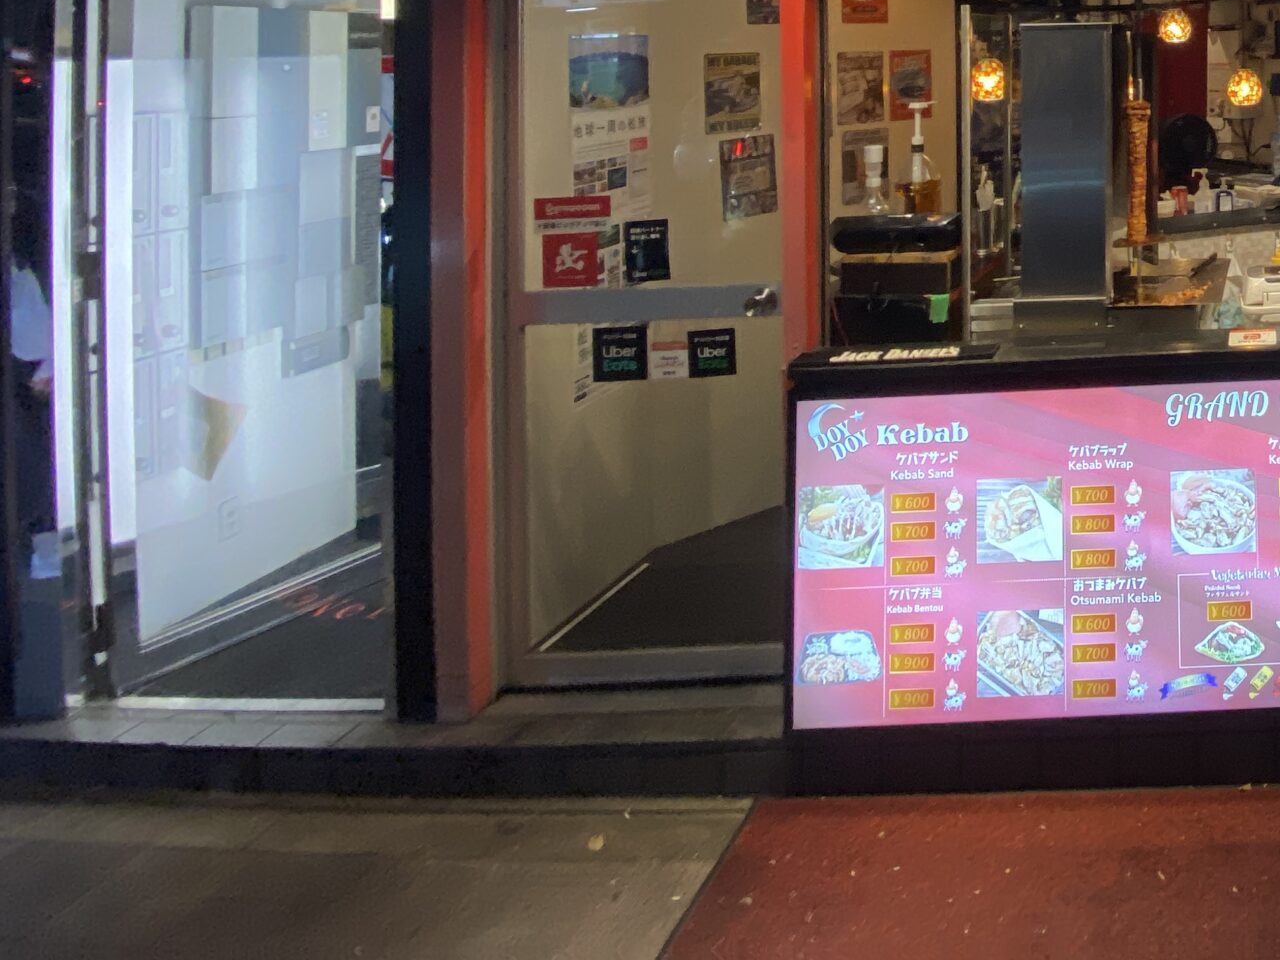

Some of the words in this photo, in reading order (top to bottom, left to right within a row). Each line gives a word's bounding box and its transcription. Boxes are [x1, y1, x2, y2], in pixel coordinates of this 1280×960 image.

[602, 346, 637, 357] Uber
[697, 346, 727, 357] Uber
[1165, 390, 1269, 427] GRAND
[813, 420, 850, 451] DOY
[830, 429, 869, 462] DOY
[877, 422, 969, 445] Kebab
[896, 451, 959, 465] ケバブサンド
[1068, 460, 1102, 470] Kebab
[1104, 459, 1134, 470] Wrap
[890, 469, 925, 480] Kebab
[928, 468, 954, 479] Sand
[1073, 577, 1147, 592] おつまみケバブ
[888, 586, 942, 600] ケバブ弁当
[1070, 594, 1124, 605] Otsumami
[1127, 592, 1161, 604] Kebab
[886, 605, 913, 614] Kebab
[914, 604, 944, 612] Bentou
